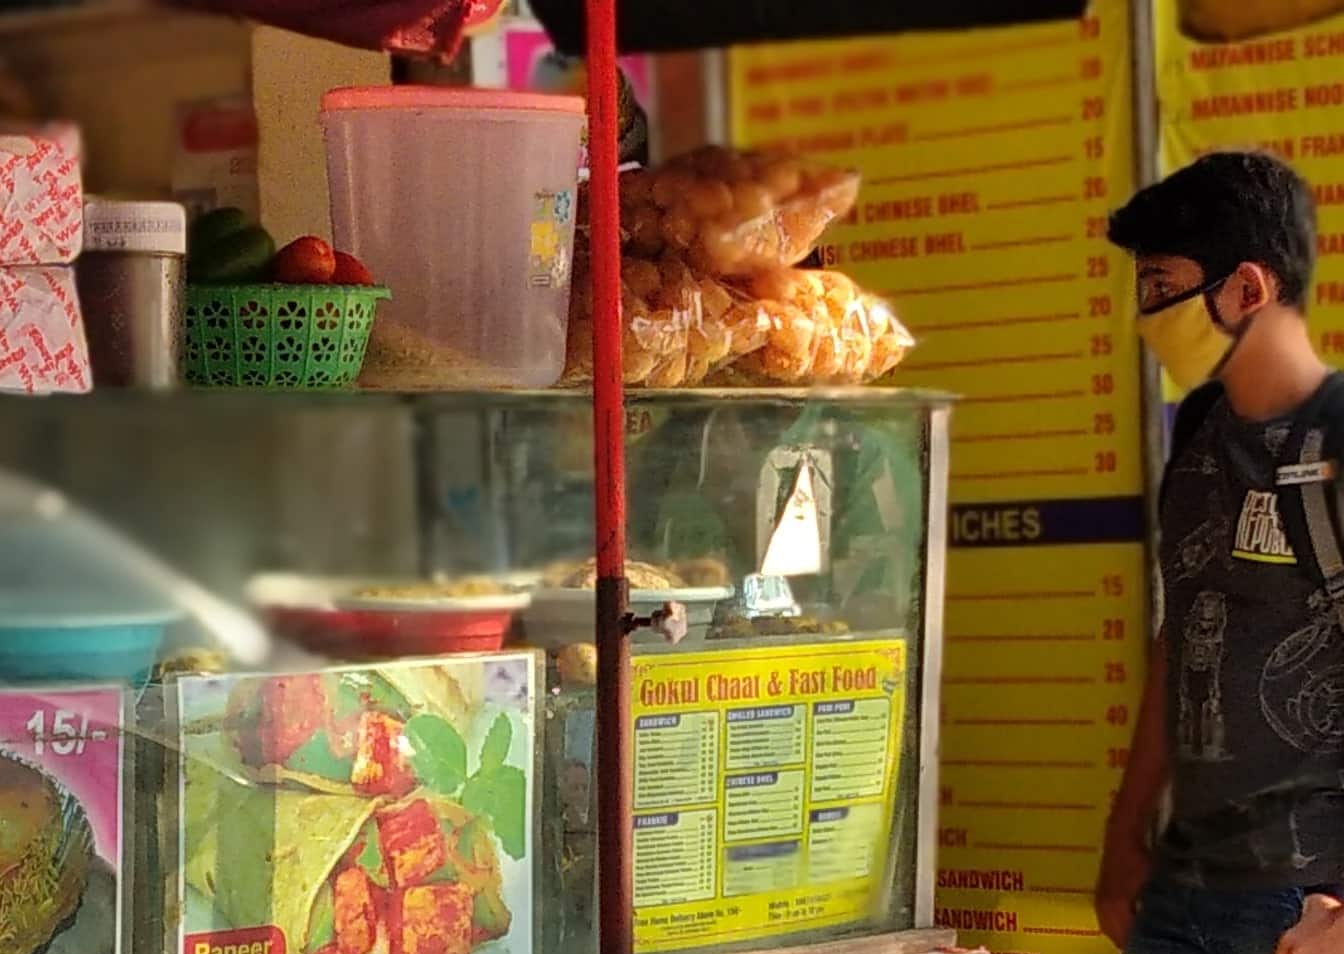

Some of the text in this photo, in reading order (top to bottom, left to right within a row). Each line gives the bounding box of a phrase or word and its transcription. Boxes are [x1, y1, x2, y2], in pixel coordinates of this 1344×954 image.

[640, 666, 876, 707] Gokul Chaat & Fast Food
[26, 711, 106, 756] 15/-
[937, 869, 1025, 892] SANDWICH
